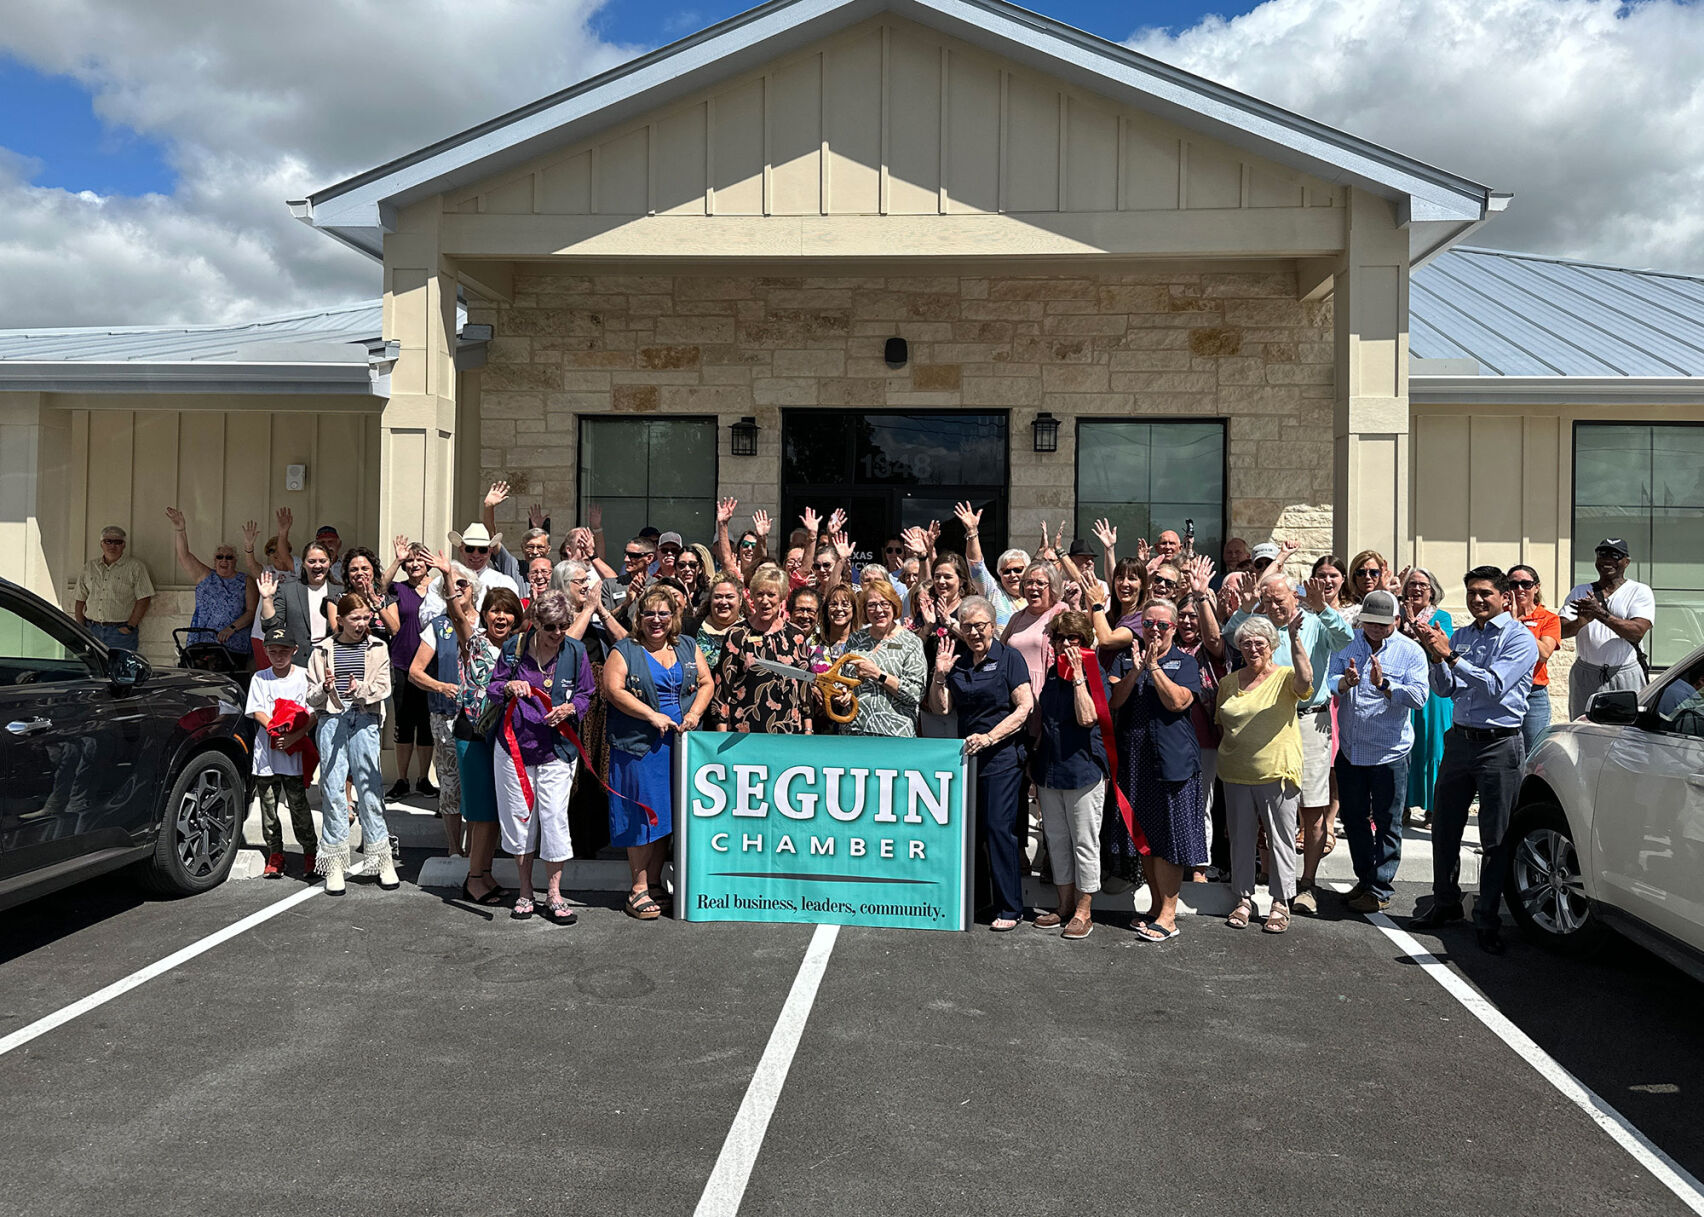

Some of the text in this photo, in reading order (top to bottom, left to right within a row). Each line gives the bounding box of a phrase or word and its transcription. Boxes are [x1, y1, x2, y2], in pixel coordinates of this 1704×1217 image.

[860, 453, 931, 478] 1348
[692, 763, 954, 825] SEGUIN
[711, 833, 926, 859] CHAMBER
[697, 894, 946, 921] Real business, leaders, community.
